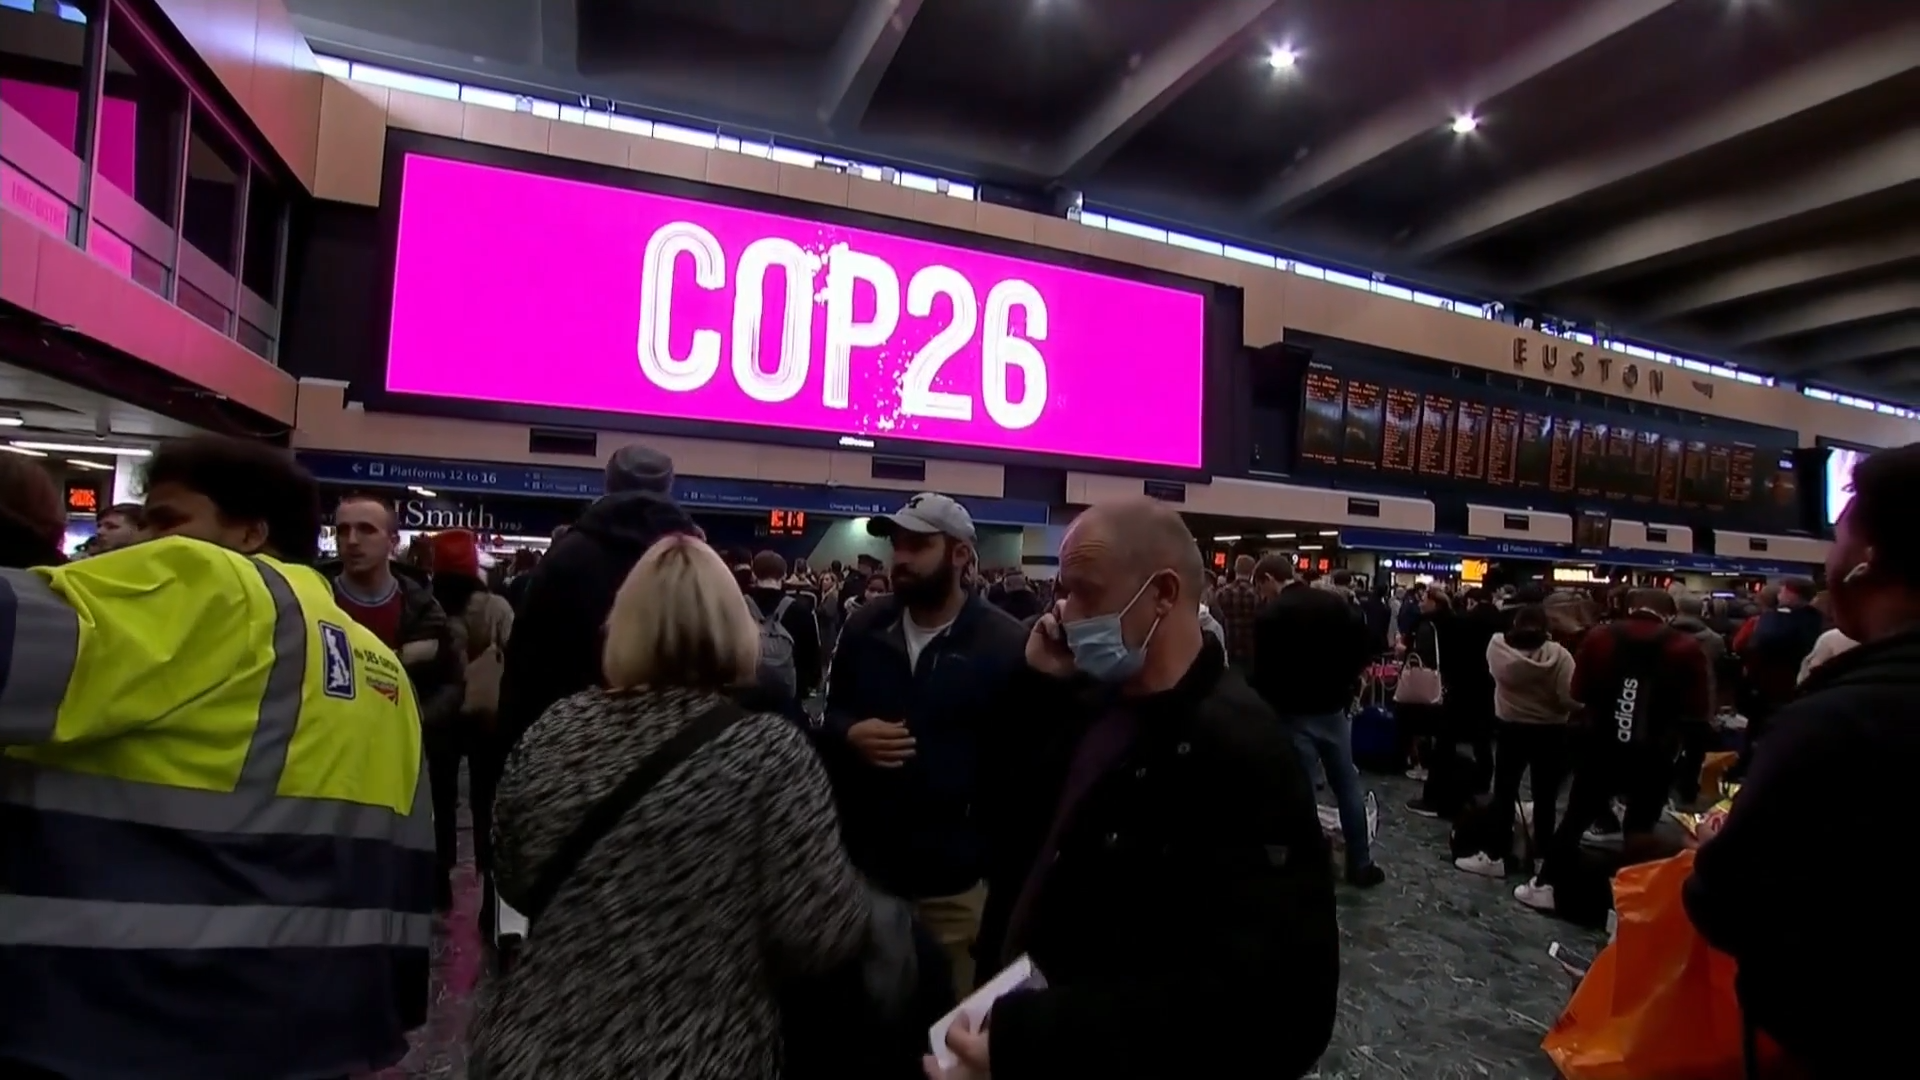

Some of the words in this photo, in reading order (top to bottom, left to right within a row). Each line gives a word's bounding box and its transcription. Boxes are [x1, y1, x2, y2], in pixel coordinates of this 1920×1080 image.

[636, 220, 1049, 430] COP26
[1512, 337, 1664, 399] EUSTON
[389, 465, 447, 480] Platforms
[448, 470, 463, 481] 12
[466, 471, 479, 482] to
[481, 472, 498, 484] 16
[1291, 553, 1299, 566] 9
[1614, 678, 1639, 743] adidas
